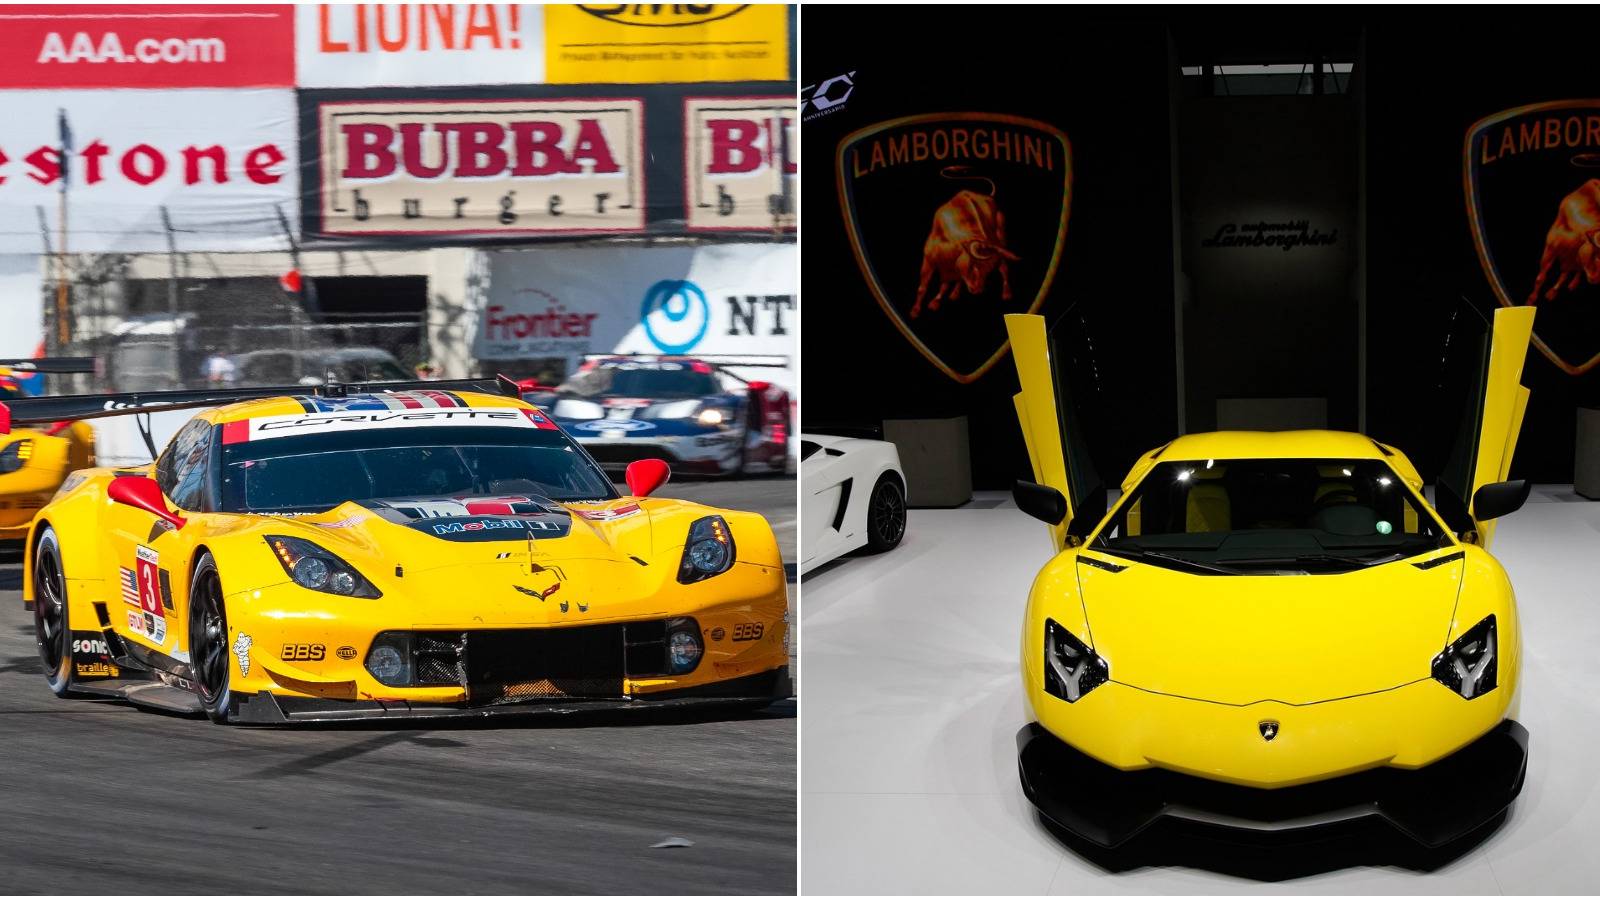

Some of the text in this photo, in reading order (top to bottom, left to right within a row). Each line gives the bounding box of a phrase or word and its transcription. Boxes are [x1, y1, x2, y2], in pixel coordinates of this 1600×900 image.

[37, 31, 226, 64] AAA.com
[0, 138, 286, 186] stone
[341, 119, 620, 178] BUBBA
[852, 128, 1053, 178] LAMBORGHINI
[1201, 223, 1339, 251] Lamborghini
[257, 408, 520, 432] CORVETTE
[433, 519, 525, 535] Mobil
[143, 563, 156, 612] 3
[732, 622, 764, 642] BBS
[281, 643, 326, 661] BBS
[77, 662, 109, 672] braille
